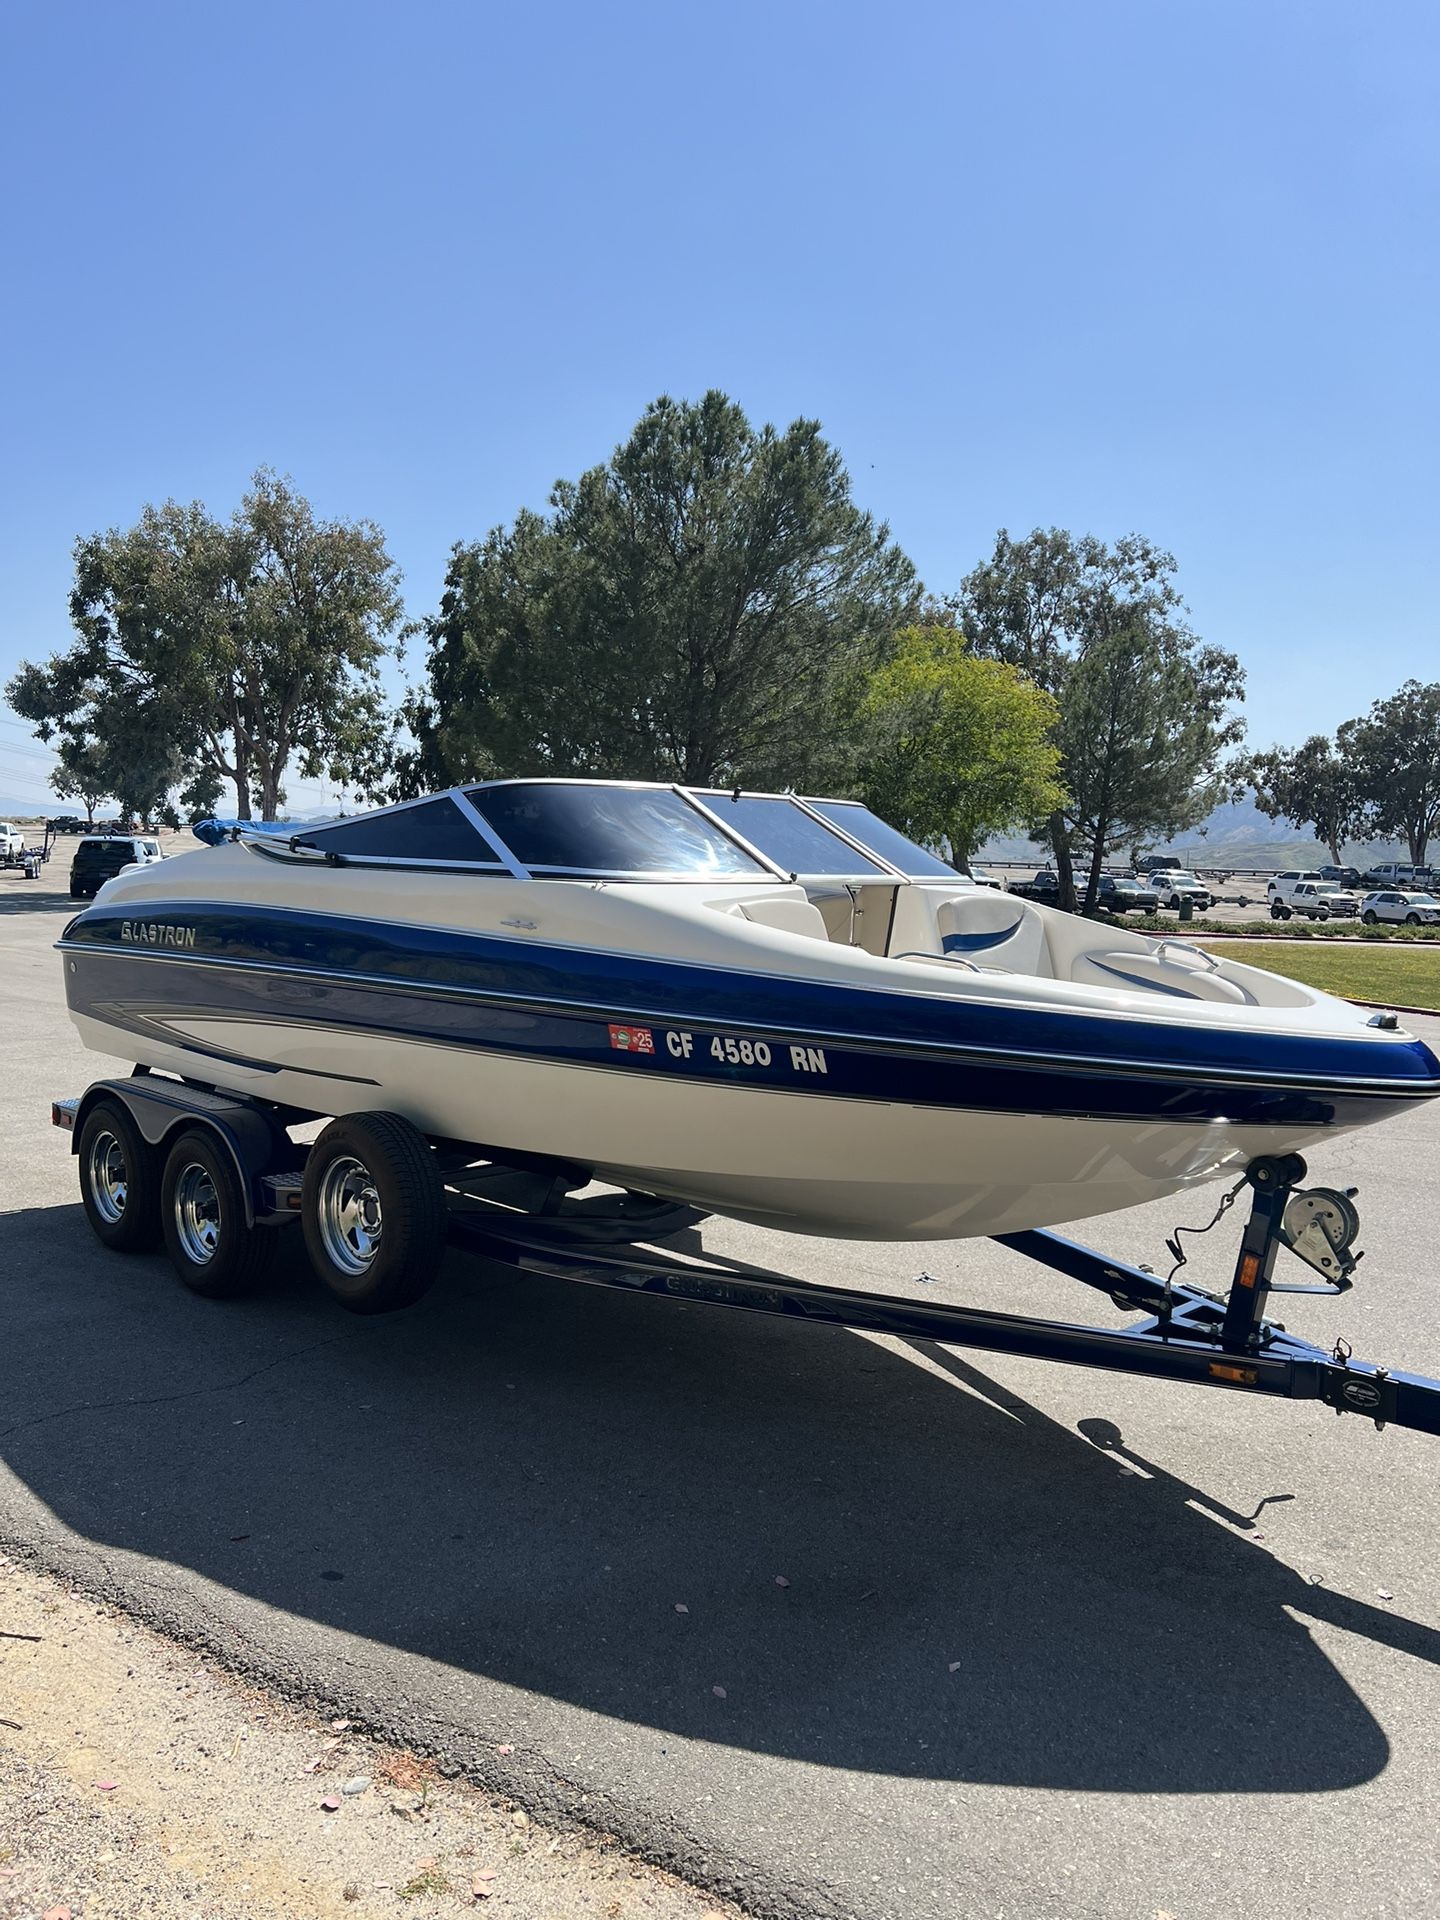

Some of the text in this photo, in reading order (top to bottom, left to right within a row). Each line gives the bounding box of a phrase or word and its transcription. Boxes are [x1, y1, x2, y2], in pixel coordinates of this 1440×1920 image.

[121, 921, 196, 947] GLASTRON
[637, 1032, 653, 1048] 25
[666, 1031, 828, 1073] CF 4580 RN
